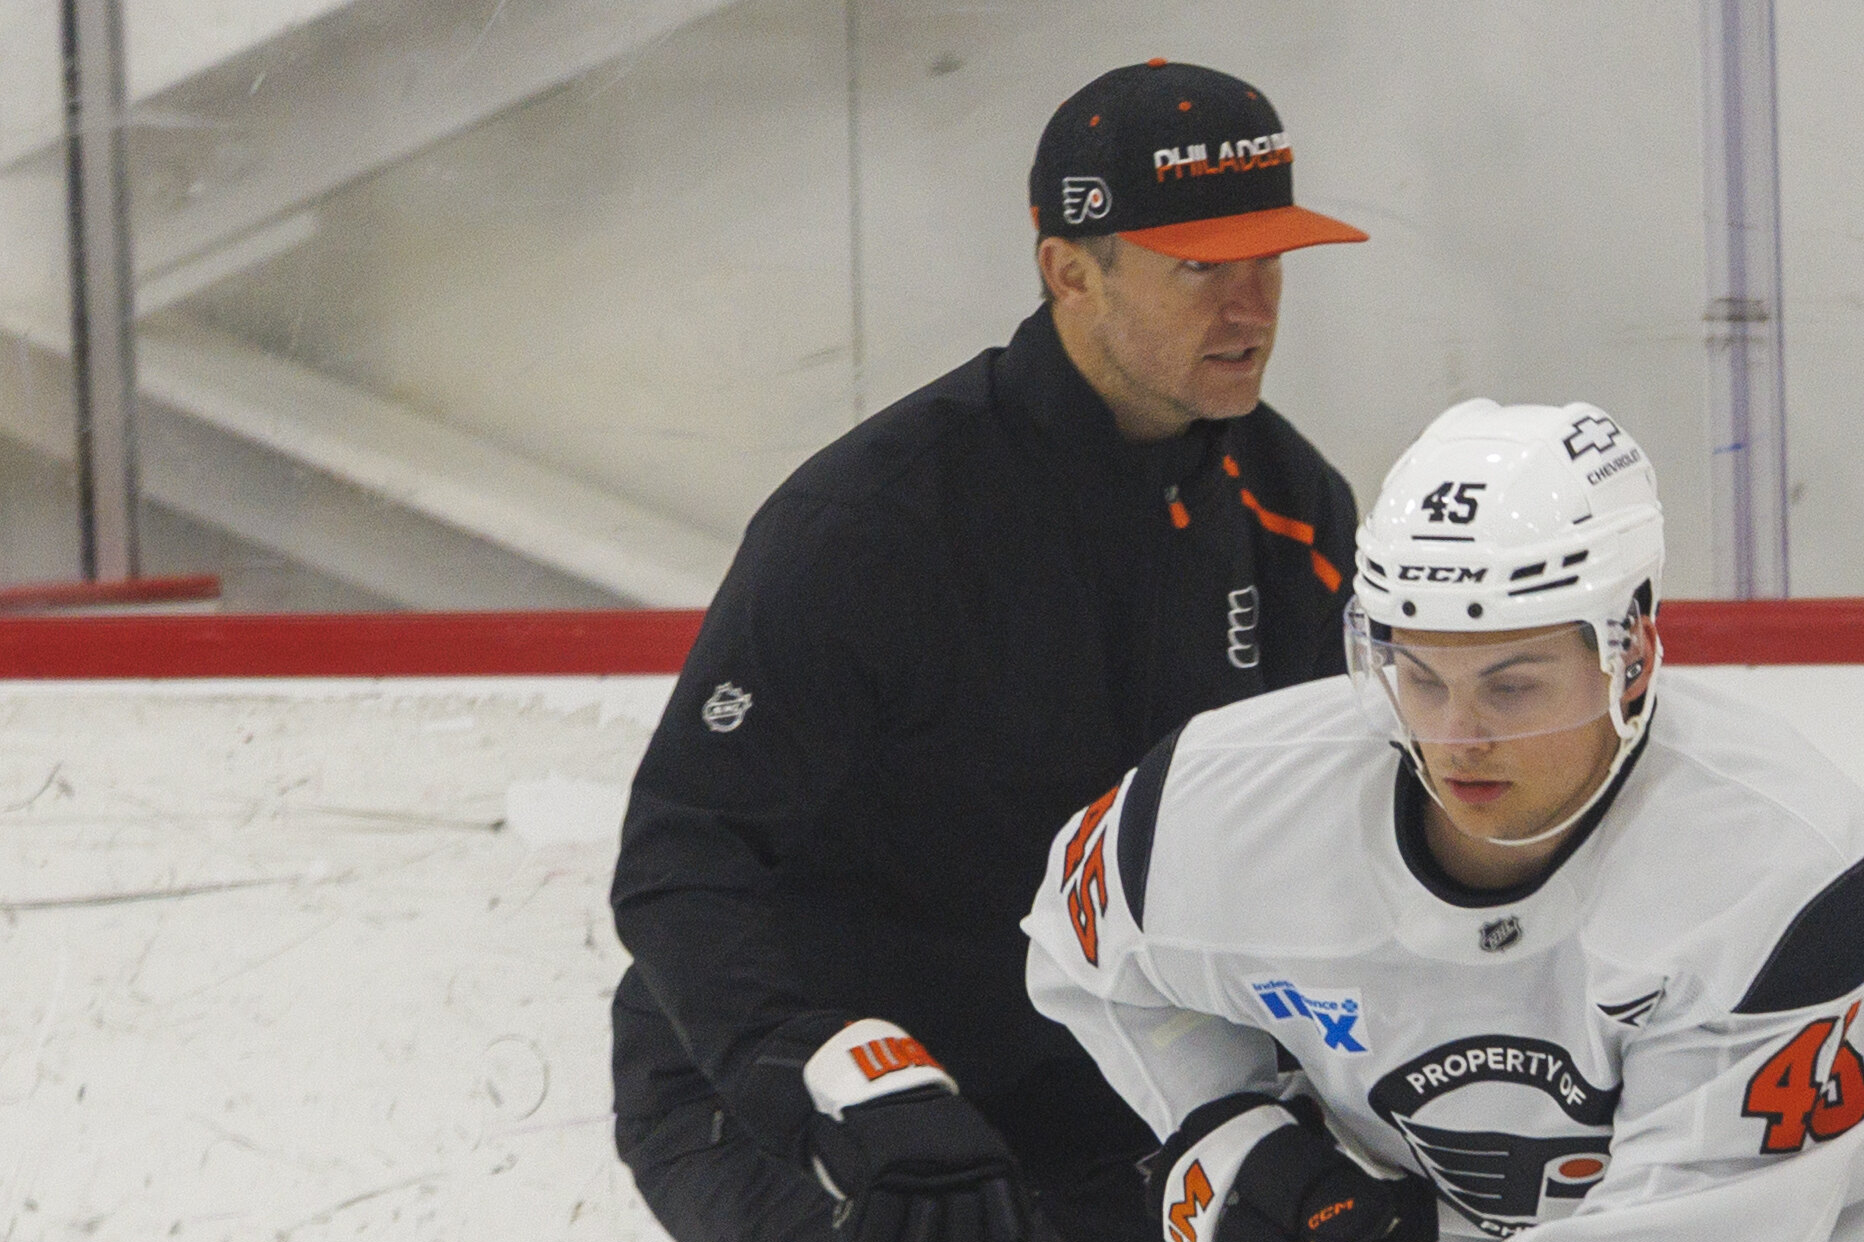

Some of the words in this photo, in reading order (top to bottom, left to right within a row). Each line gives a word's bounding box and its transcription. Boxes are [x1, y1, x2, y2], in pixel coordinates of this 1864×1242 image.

[1421, 481, 1487, 525] 45
[1397, 565, 1488, 583] CCM
[1405, 1047, 1563, 1095] PROPERTY
[1559, 1071, 1587, 1106] OF
[1307, 1199, 1355, 1231] CCM
